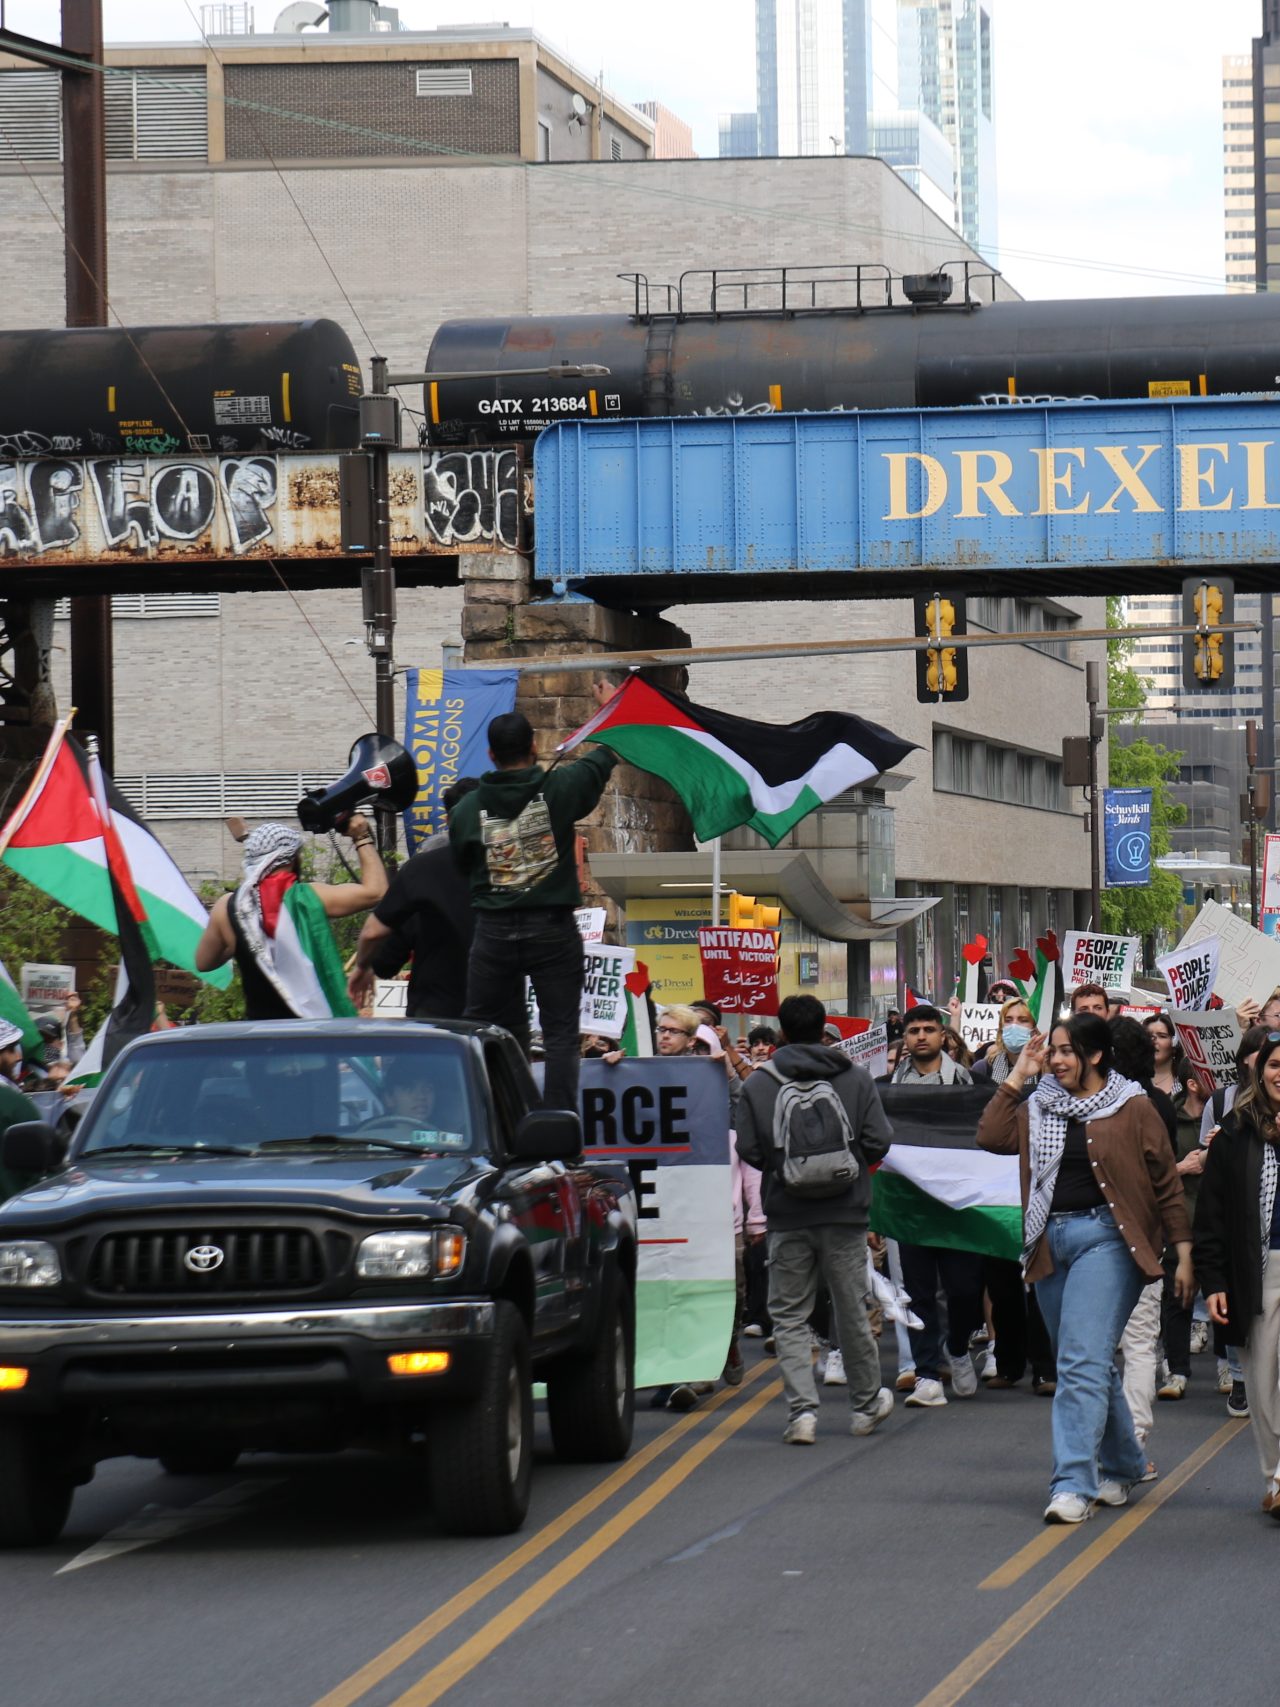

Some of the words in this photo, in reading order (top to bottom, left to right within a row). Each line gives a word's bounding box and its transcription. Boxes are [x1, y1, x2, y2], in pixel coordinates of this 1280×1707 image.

[478, 399, 523, 414] GATX
[532, 396, 588, 412] 213684
[1105, 803, 1150, 814] Schuylkill
[1113, 814, 1141, 827] Yards
[700, 931, 775, 950] INTIFADA
[1076, 939, 1129, 956] PEOPLE
[704, 949, 732, 960] UNTIL
[738, 951, 776, 963] VICTORY
[1074, 953, 1125, 972] POWER
[1073, 968, 1093, 979] WEST
[1102, 973, 1123, 983] WEST
[1168, 954, 1211, 987] PEOPLE
[1175, 975, 1209, 1008] POWER
[593, 998, 618, 1010] WEST
[593, 1010, 616, 1020] BANK
[964, 1008, 994, 1020] VIVA
[1212, 1041, 1224, 1051] AS
